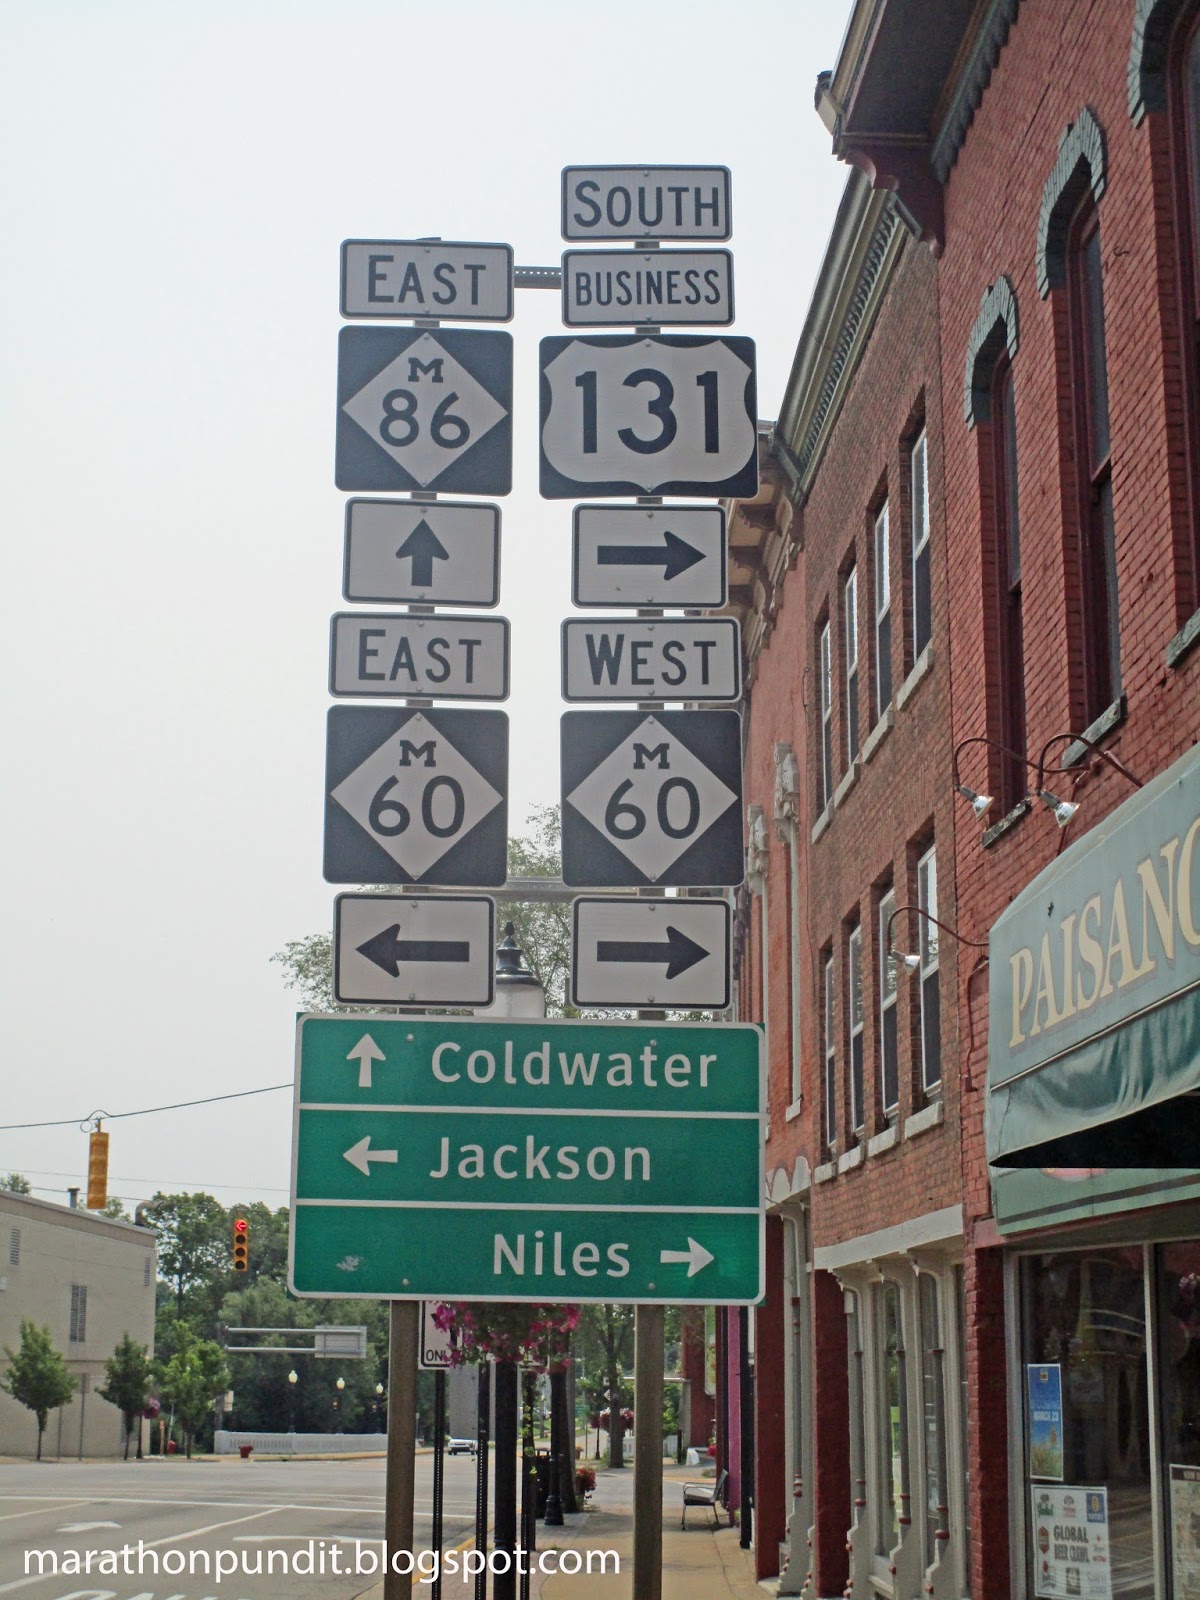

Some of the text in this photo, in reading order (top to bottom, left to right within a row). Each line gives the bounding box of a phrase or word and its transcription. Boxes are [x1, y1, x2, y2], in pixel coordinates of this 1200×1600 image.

[574, 180, 719, 227] SOUTH
[367, 254, 486, 306] EAST
[576, 270, 721, 306] BUSINESS
[408, 357, 443, 383] M
[379, 388, 470, 449] 86
[575, 368, 720, 455] 131
[358, 629, 482, 683] EAST
[585, 634, 717, 686] WEST
[399, 740, 436, 767] M
[633, 743, 670, 769] M
[368, 775, 465, 838] 60
[604, 776, 700, 839] 60
[431, 1040, 717, 1088] Coldwater
[430, 1135, 651, 1181] Jackson
[493, 1230, 630, 1277] Niles
[1053, 1524, 1089, 1543] GLOBAL
